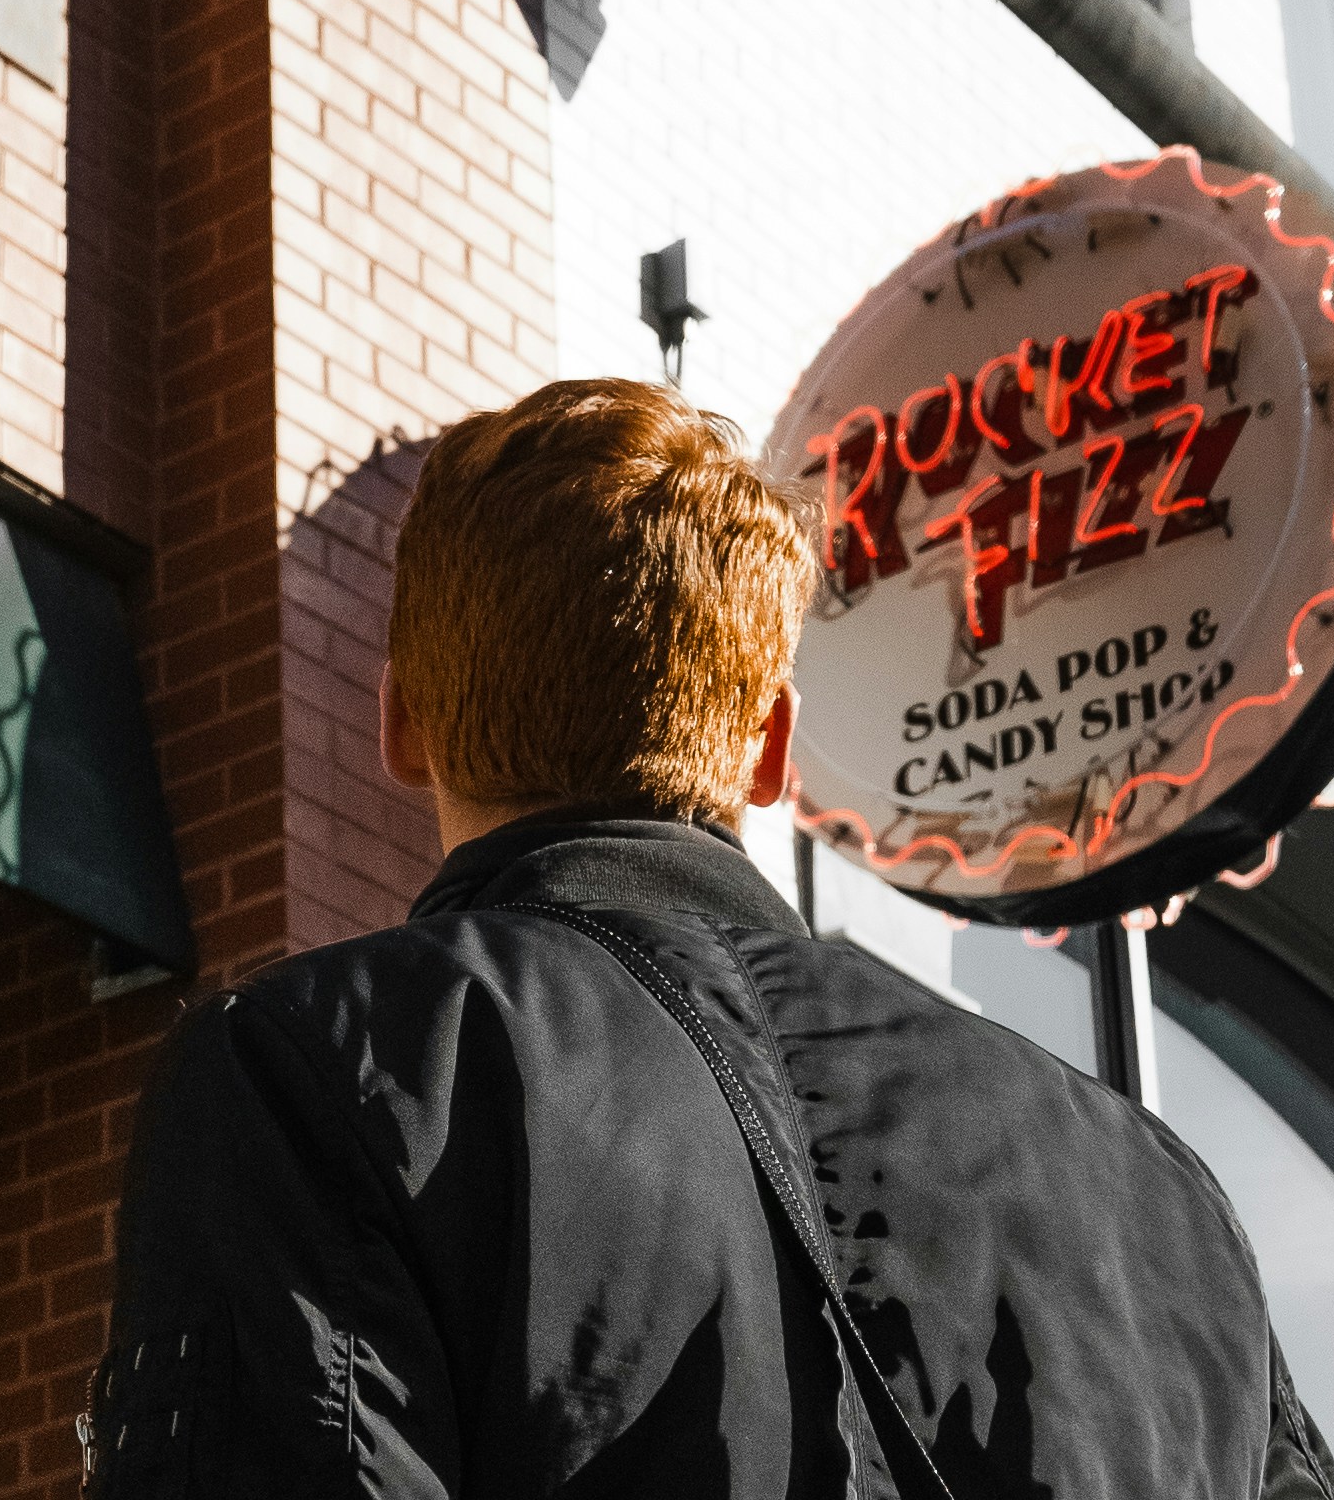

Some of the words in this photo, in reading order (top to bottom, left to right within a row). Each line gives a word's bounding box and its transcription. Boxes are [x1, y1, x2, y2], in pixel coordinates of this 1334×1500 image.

[801, 265, 1259, 595] ROCKET
[917, 404, 1253, 653] FIZZ
[893, 708, 1064, 798] CANDY
[1080, 659, 1235, 742] SHOP
[902, 669, 1043, 743] SODA
[1056, 624, 1168, 693] POP
[1185, 607, 1220, 650] &
